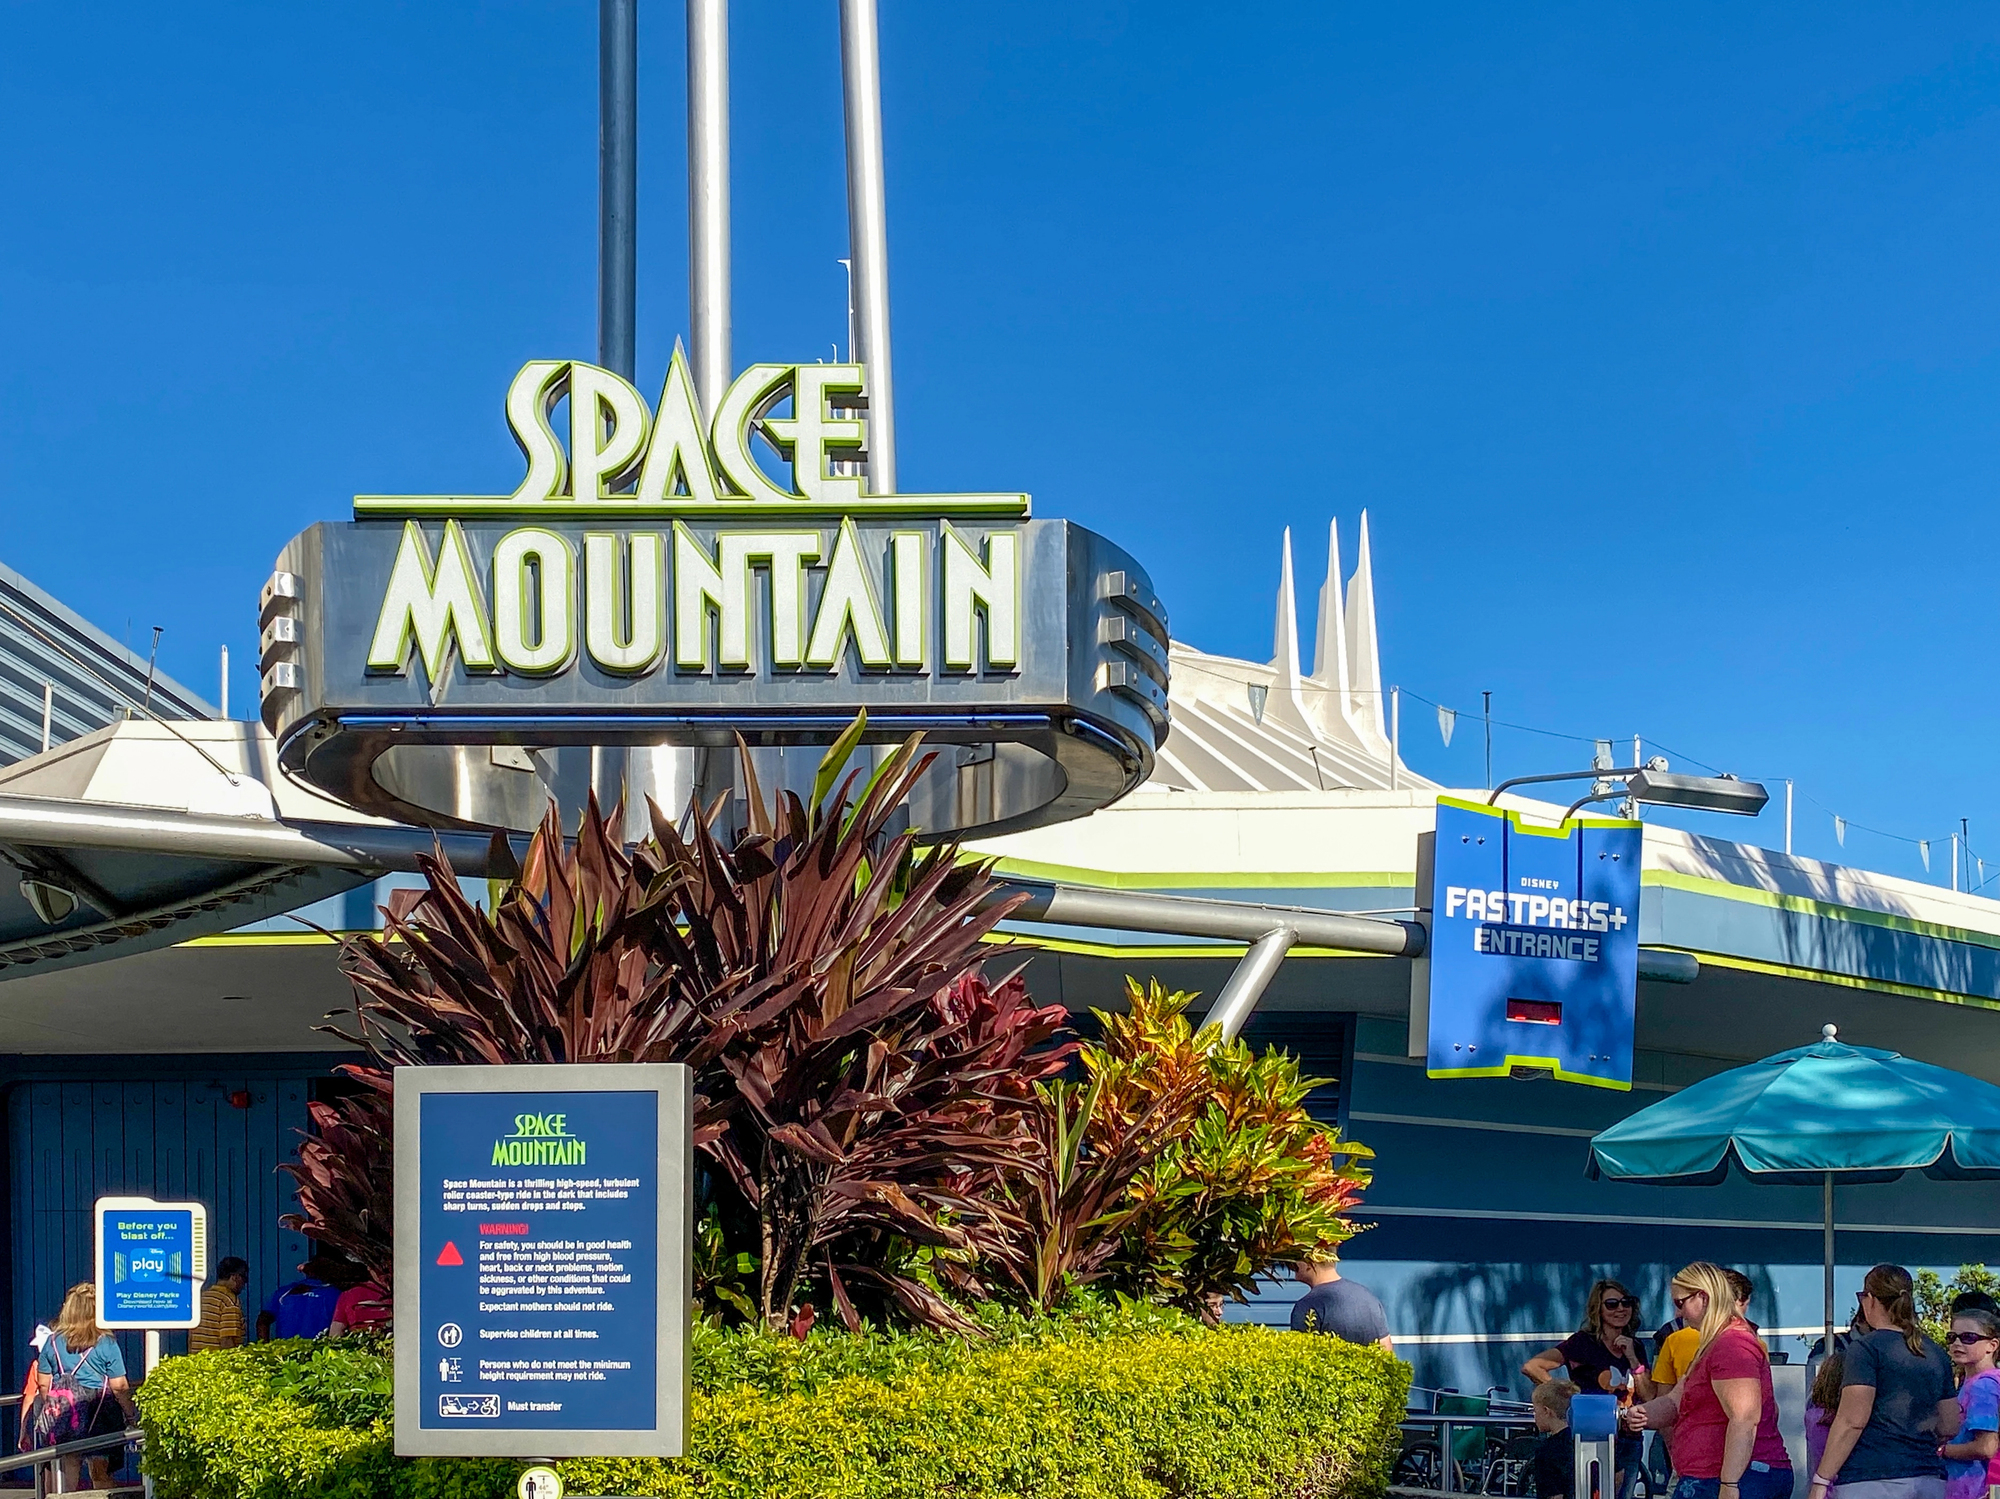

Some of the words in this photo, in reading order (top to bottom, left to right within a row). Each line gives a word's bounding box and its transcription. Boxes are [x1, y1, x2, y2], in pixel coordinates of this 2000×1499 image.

[506, 335, 868, 501] SPACE
[367, 516, 1020, 688] MOUNTAIN
[1521, 877, 1559, 890] DISNEY
[1445, 886, 1628, 933] FASTPASS+
[1473, 927, 1599, 962] ENTRANCE
[514, 1111, 567, 1136] SPACE
[491, 1138, 586, 1168] MOUNTAIN
[443, 1180, 467, 1190] Space
[469, 1179, 506, 1188] Mountain
[508, 1179, 516, 1188] is
[524, 1179, 555, 1189] thrilling
[556, 1178, 602, 1189] high-speed,
[603, 1178, 640, 1188] turbulent
[443, 1190, 464, 1199] roller
[465, 1191, 514, 1201] coaster-type
[516, 1190, 532, 1199] ride
[533, 1190, 541, 1199] in
[542, 1190, 556, 1199] the
[557, 1190, 576, 1198] dark
[577, 1190, 593, 1198] that
[595, 1189, 629, 1198] includes
[443, 1202, 465, 1212] sharp
[467, 1202, 490, 1211] turns,
[491, 1201, 520, 1210] sudden
[521, 1201, 544, 1212] drops
[545, 1201, 560, 1210] and
[562, 1201, 586, 1211] stops.
[118, 1222, 154, 1230] Before
[157, 1223, 177, 1231] you
[479, 1223, 529, 1235] WARNING!
[121, 1231, 148, 1240] blast
[151, 1231, 174, 1240] off...
[479, 1241, 493, 1249] For
[494, 1241, 520, 1251] safety,
[521, 1243, 535, 1251] you
[537, 1241, 564, 1249] should
[565, 1241, 575, 1249] be
[576, 1241, 584, 1249] in
[586, 1241, 605, 1251] good
[607, 1240, 632, 1249] health
[479, 1252, 495, 1261] and
[496, 1252, 512, 1261] free
[513, 1252, 532, 1261] from
[534, 1252, 551, 1262] high
[552, 1252, 574, 1260] blood
[575, 1253, 612, 1262] pressure,
[132, 1257, 163, 1273] play
[479, 1263, 502, 1273] heart,
[504, 1263, 523, 1272] back
[535, 1263, 554, 1272] neck
[555, 1263, 594, 1273] problems,
[596, 1263, 624, 1271] motion
[479, 1274, 516, 1284] sickness,
[527, 1274, 548, 1283] other
[549, 1274, 591, 1283] conditions
[591, 1274, 608, 1283] that
[609, 1274, 631, 1282] could
[479, 1286, 489, 1294] be
[491, 1286, 535, 1296] aggravated
[536, 1285, 546, 1296] by
[547, 1285, 563, 1294] this
[564, 1285, 605, 1294] adventure.
[479, 1302, 519, 1312] Expectant
[520, 1302, 553, 1311] mothers
[554, 1302, 581, 1311] should
[582, 1302, 596, 1310] not
[597, 1302, 614, 1310] ride.
[479, 1329, 519, 1339] Supervise
[520, 1329, 552, 1338] children
[553, 1330, 562, 1338] at
[563, 1329, 573, 1338] all
[574, 1329, 599, 1338] times.
[479, 1360, 511, 1369] Persons
[512, 1360, 529, 1369] who
[530, 1360, 541, 1369] do
[542, 1360, 556, 1369] not
[557, 1360, 577, 1369] meet
[579, 1360, 592, 1369] the
[593, 1360, 631, 1369] minimum
[479, 1371, 504, 1381] height
[506, 1371, 556, 1381] requirement
[557, 1373, 572, 1381] may
[573, 1371, 587, 1380] not
[588, 1371, 606, 1380] ride.
[507, 1402, 529, 1410] Must
[530, 1402, 563, 1410] transfer
